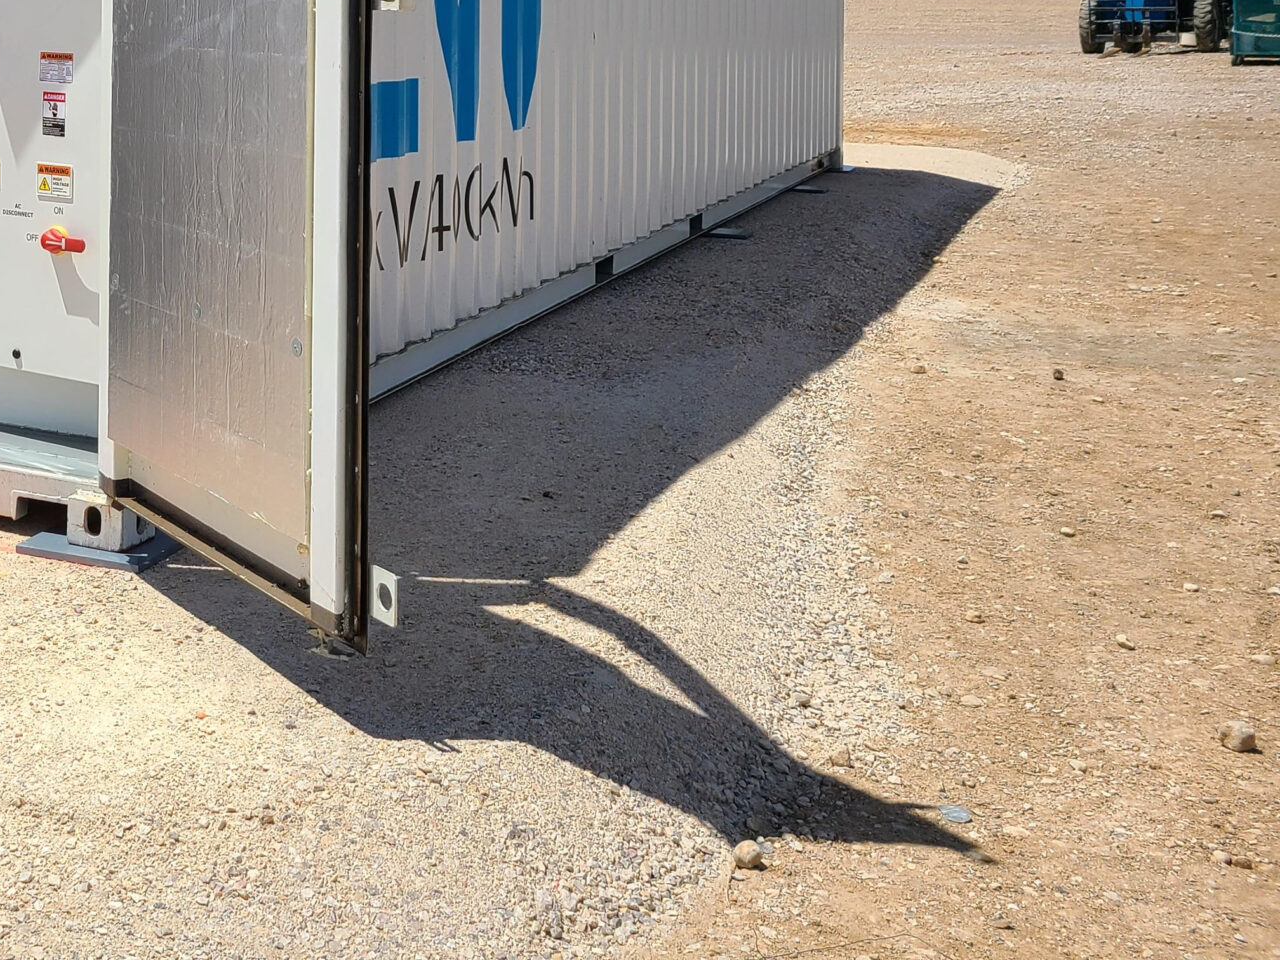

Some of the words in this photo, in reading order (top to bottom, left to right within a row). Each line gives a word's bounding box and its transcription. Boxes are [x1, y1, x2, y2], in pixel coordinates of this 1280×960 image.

[44, 166, 69, 175] WARNING
[2, 209, 34, 218] DISCONNECT
[53, 206, 64, 215] ON
[26, 232, 39, 242] OFF
